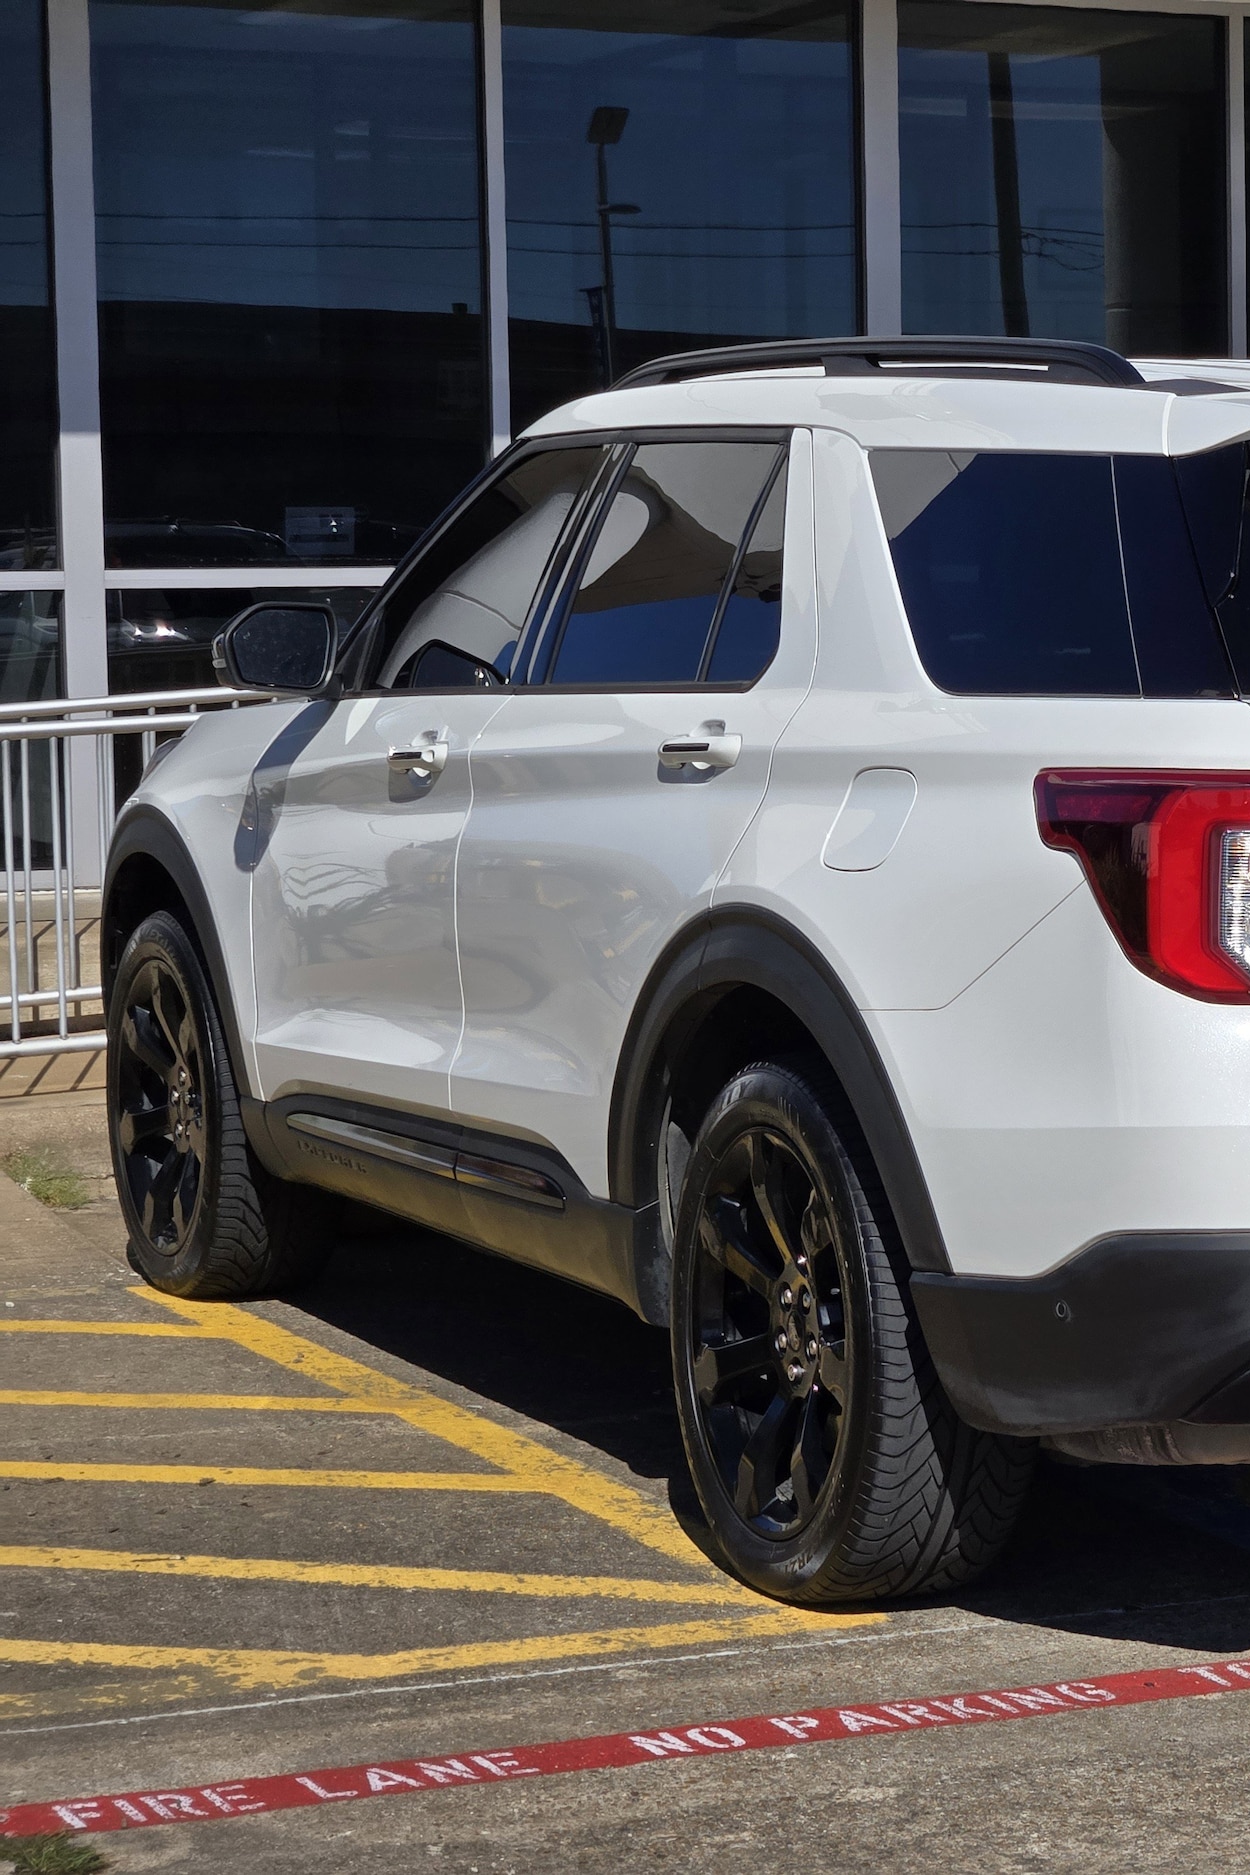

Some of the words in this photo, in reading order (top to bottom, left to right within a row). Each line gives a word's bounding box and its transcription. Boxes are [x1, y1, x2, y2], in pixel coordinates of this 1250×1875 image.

[52, 1784, 266, 1829] FIRE
[295, 1752, 540, 1799] LANE
[628, 1726, 747, 1756] NO
[767, 1681, 1116, 1739] PARKING
